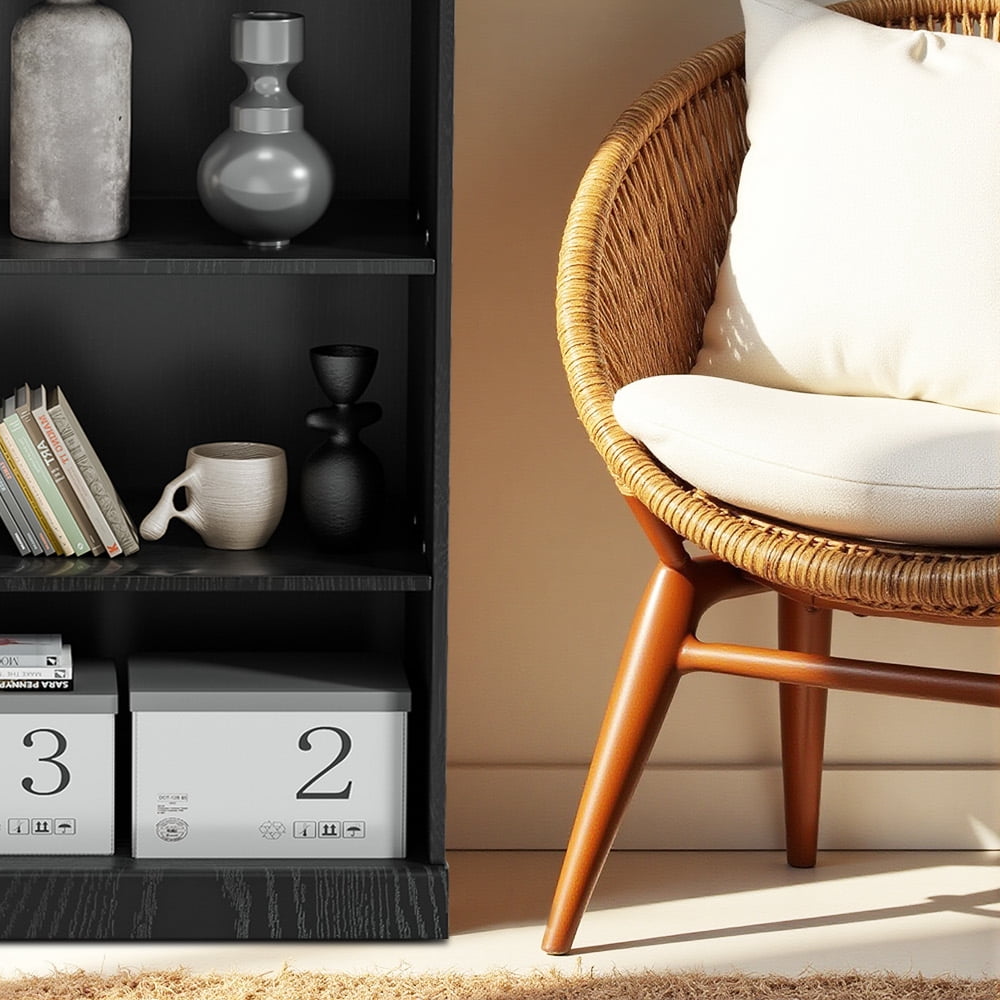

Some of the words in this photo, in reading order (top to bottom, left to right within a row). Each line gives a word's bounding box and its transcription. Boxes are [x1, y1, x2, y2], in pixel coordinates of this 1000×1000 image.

[43, 681, 69, 689] SARA
[21, 727, 72, 796] 3
[296, 725, 353, 800] 2
